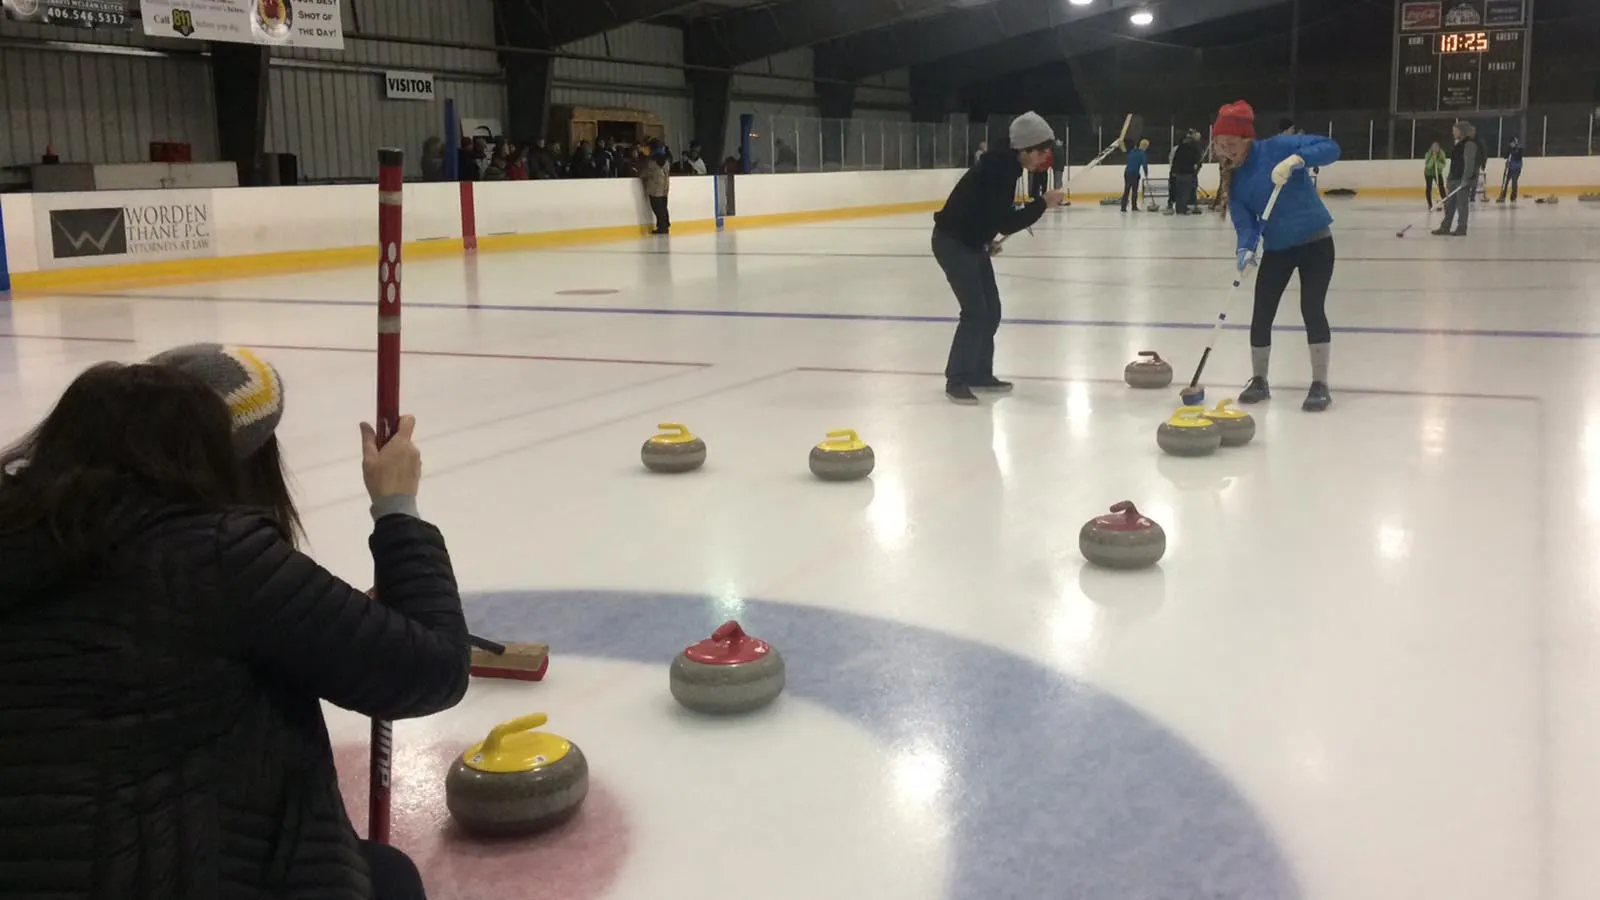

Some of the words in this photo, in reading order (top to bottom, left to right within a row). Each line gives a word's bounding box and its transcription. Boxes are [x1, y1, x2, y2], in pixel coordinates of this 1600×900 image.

[48, 7, 124, 24] 406.546.5317
[153, 15, 170, 24] Call
[173, 9, 190, 26] 811
[298, 10, 320, 20] SHOT
[297, 28, 314, 36] THE
[1441, 32, 1488, 52] 10:25
[388, 78, 432, 93] VISITOR
[125, 204, 207, 225] WORDEN
[127, 226, 180, 240] THANE
[185, 223, 210, 238] P.C.
[193, 240, 209, 249] LAW
